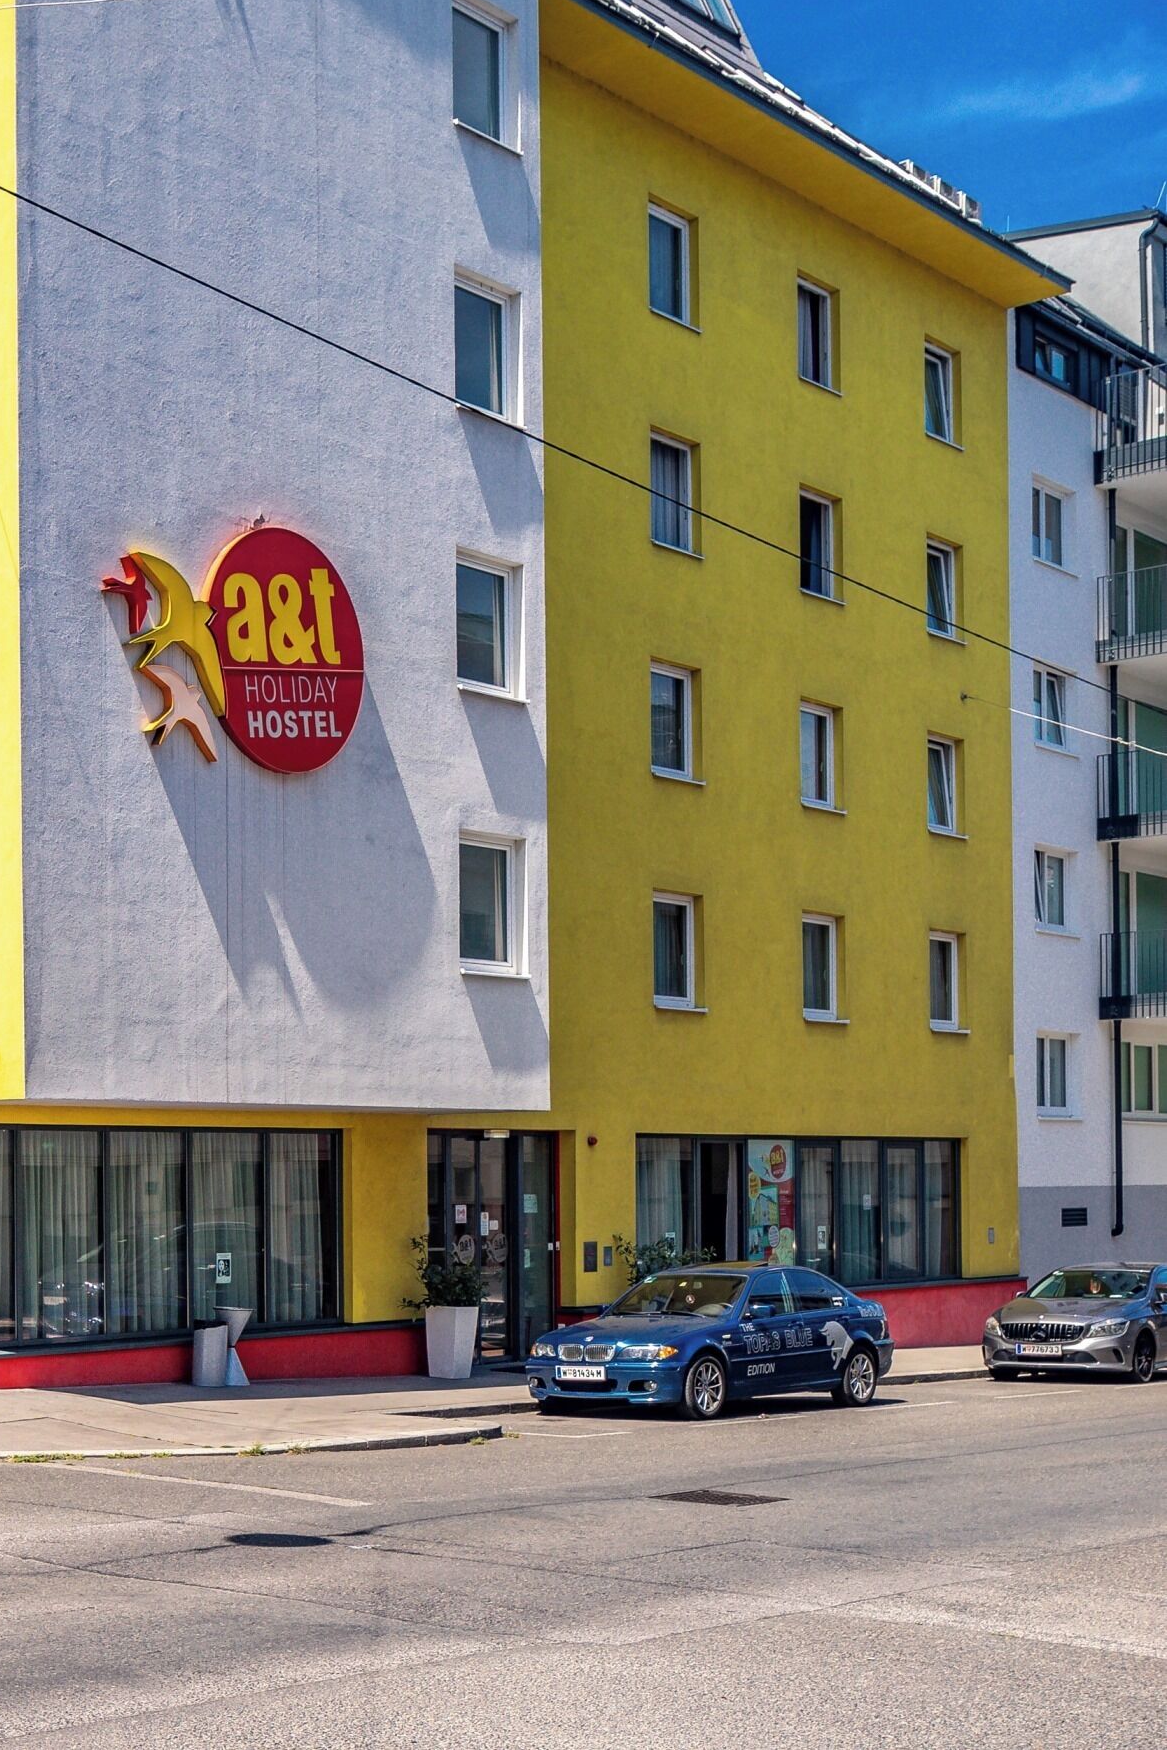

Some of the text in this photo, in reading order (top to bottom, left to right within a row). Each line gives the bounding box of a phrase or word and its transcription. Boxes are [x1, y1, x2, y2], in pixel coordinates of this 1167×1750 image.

[224, 568, 341, 665] a&t
[245, 674, 339, 703] HOLIDAY
[247, 709, 343, 739] HOSTEL
[738, 1322, 756, 1333] THE
[743, 1327, 814, 1355] TOPAS BLUE
[746, 1363, 776, 1376] EDITION
